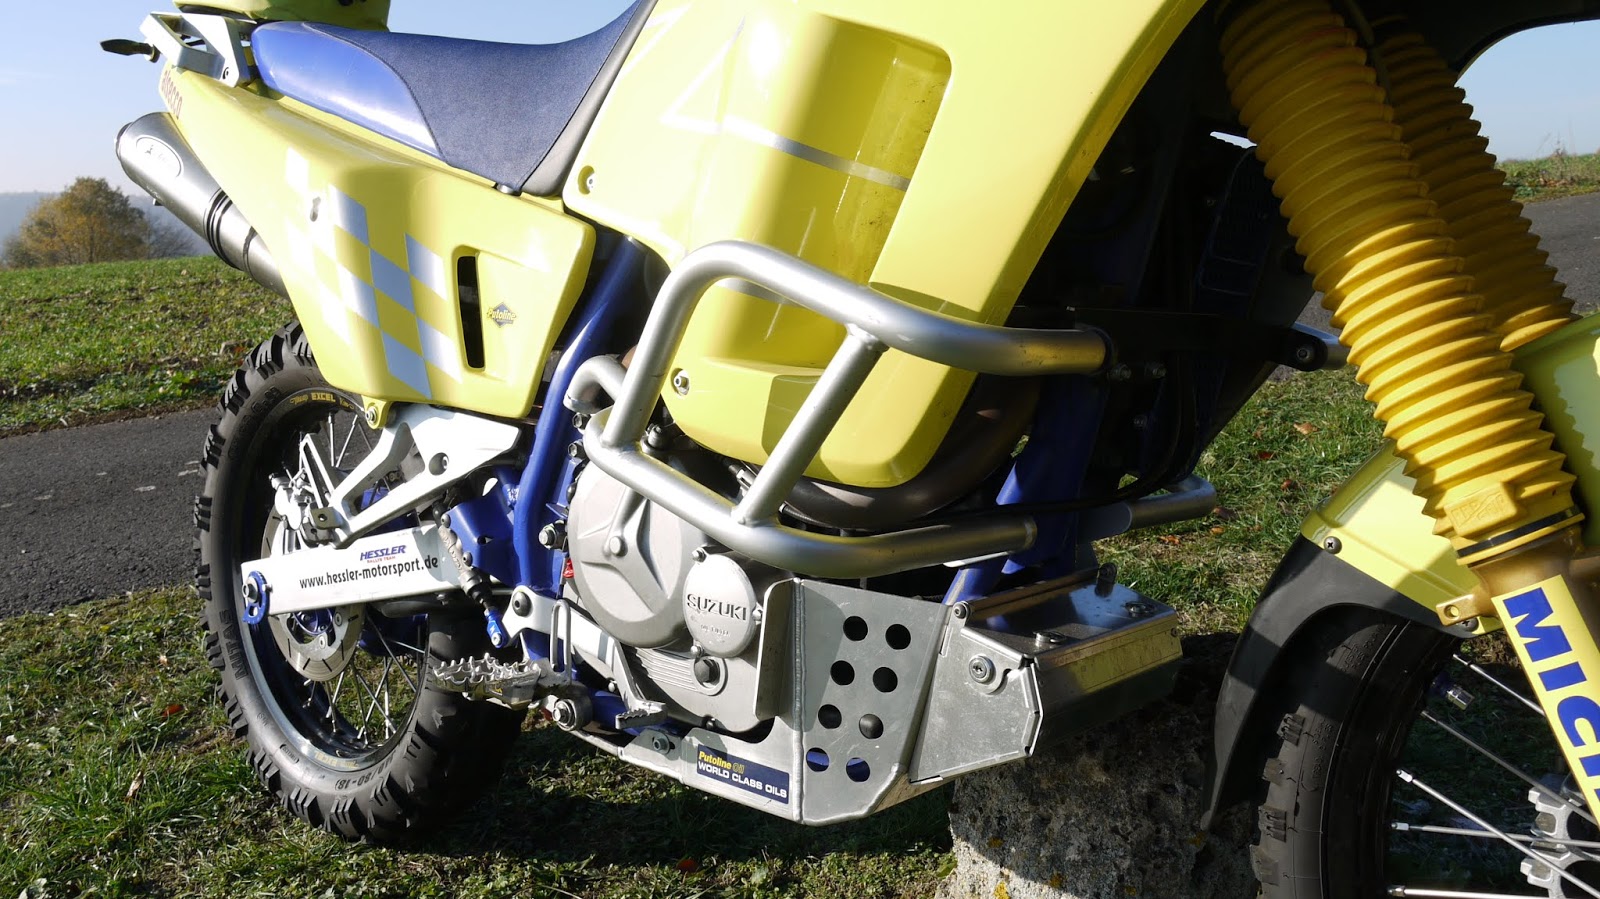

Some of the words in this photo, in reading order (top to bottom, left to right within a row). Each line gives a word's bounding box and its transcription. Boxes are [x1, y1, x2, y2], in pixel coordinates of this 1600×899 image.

[311, 392, 336, 403] EXCEL
[360, 544, 407, 561] HESSLER
[299, 554, 439, 589] www.hessler-motorsport.de
[687, 593, 747, 621] SUZUKI
[699, 751, 732, 770] Putoline
[698, 761, 730, 779] WORLD
[731, 773, 763, 791] CLASS
[765, 784, 787, 799] OILS
